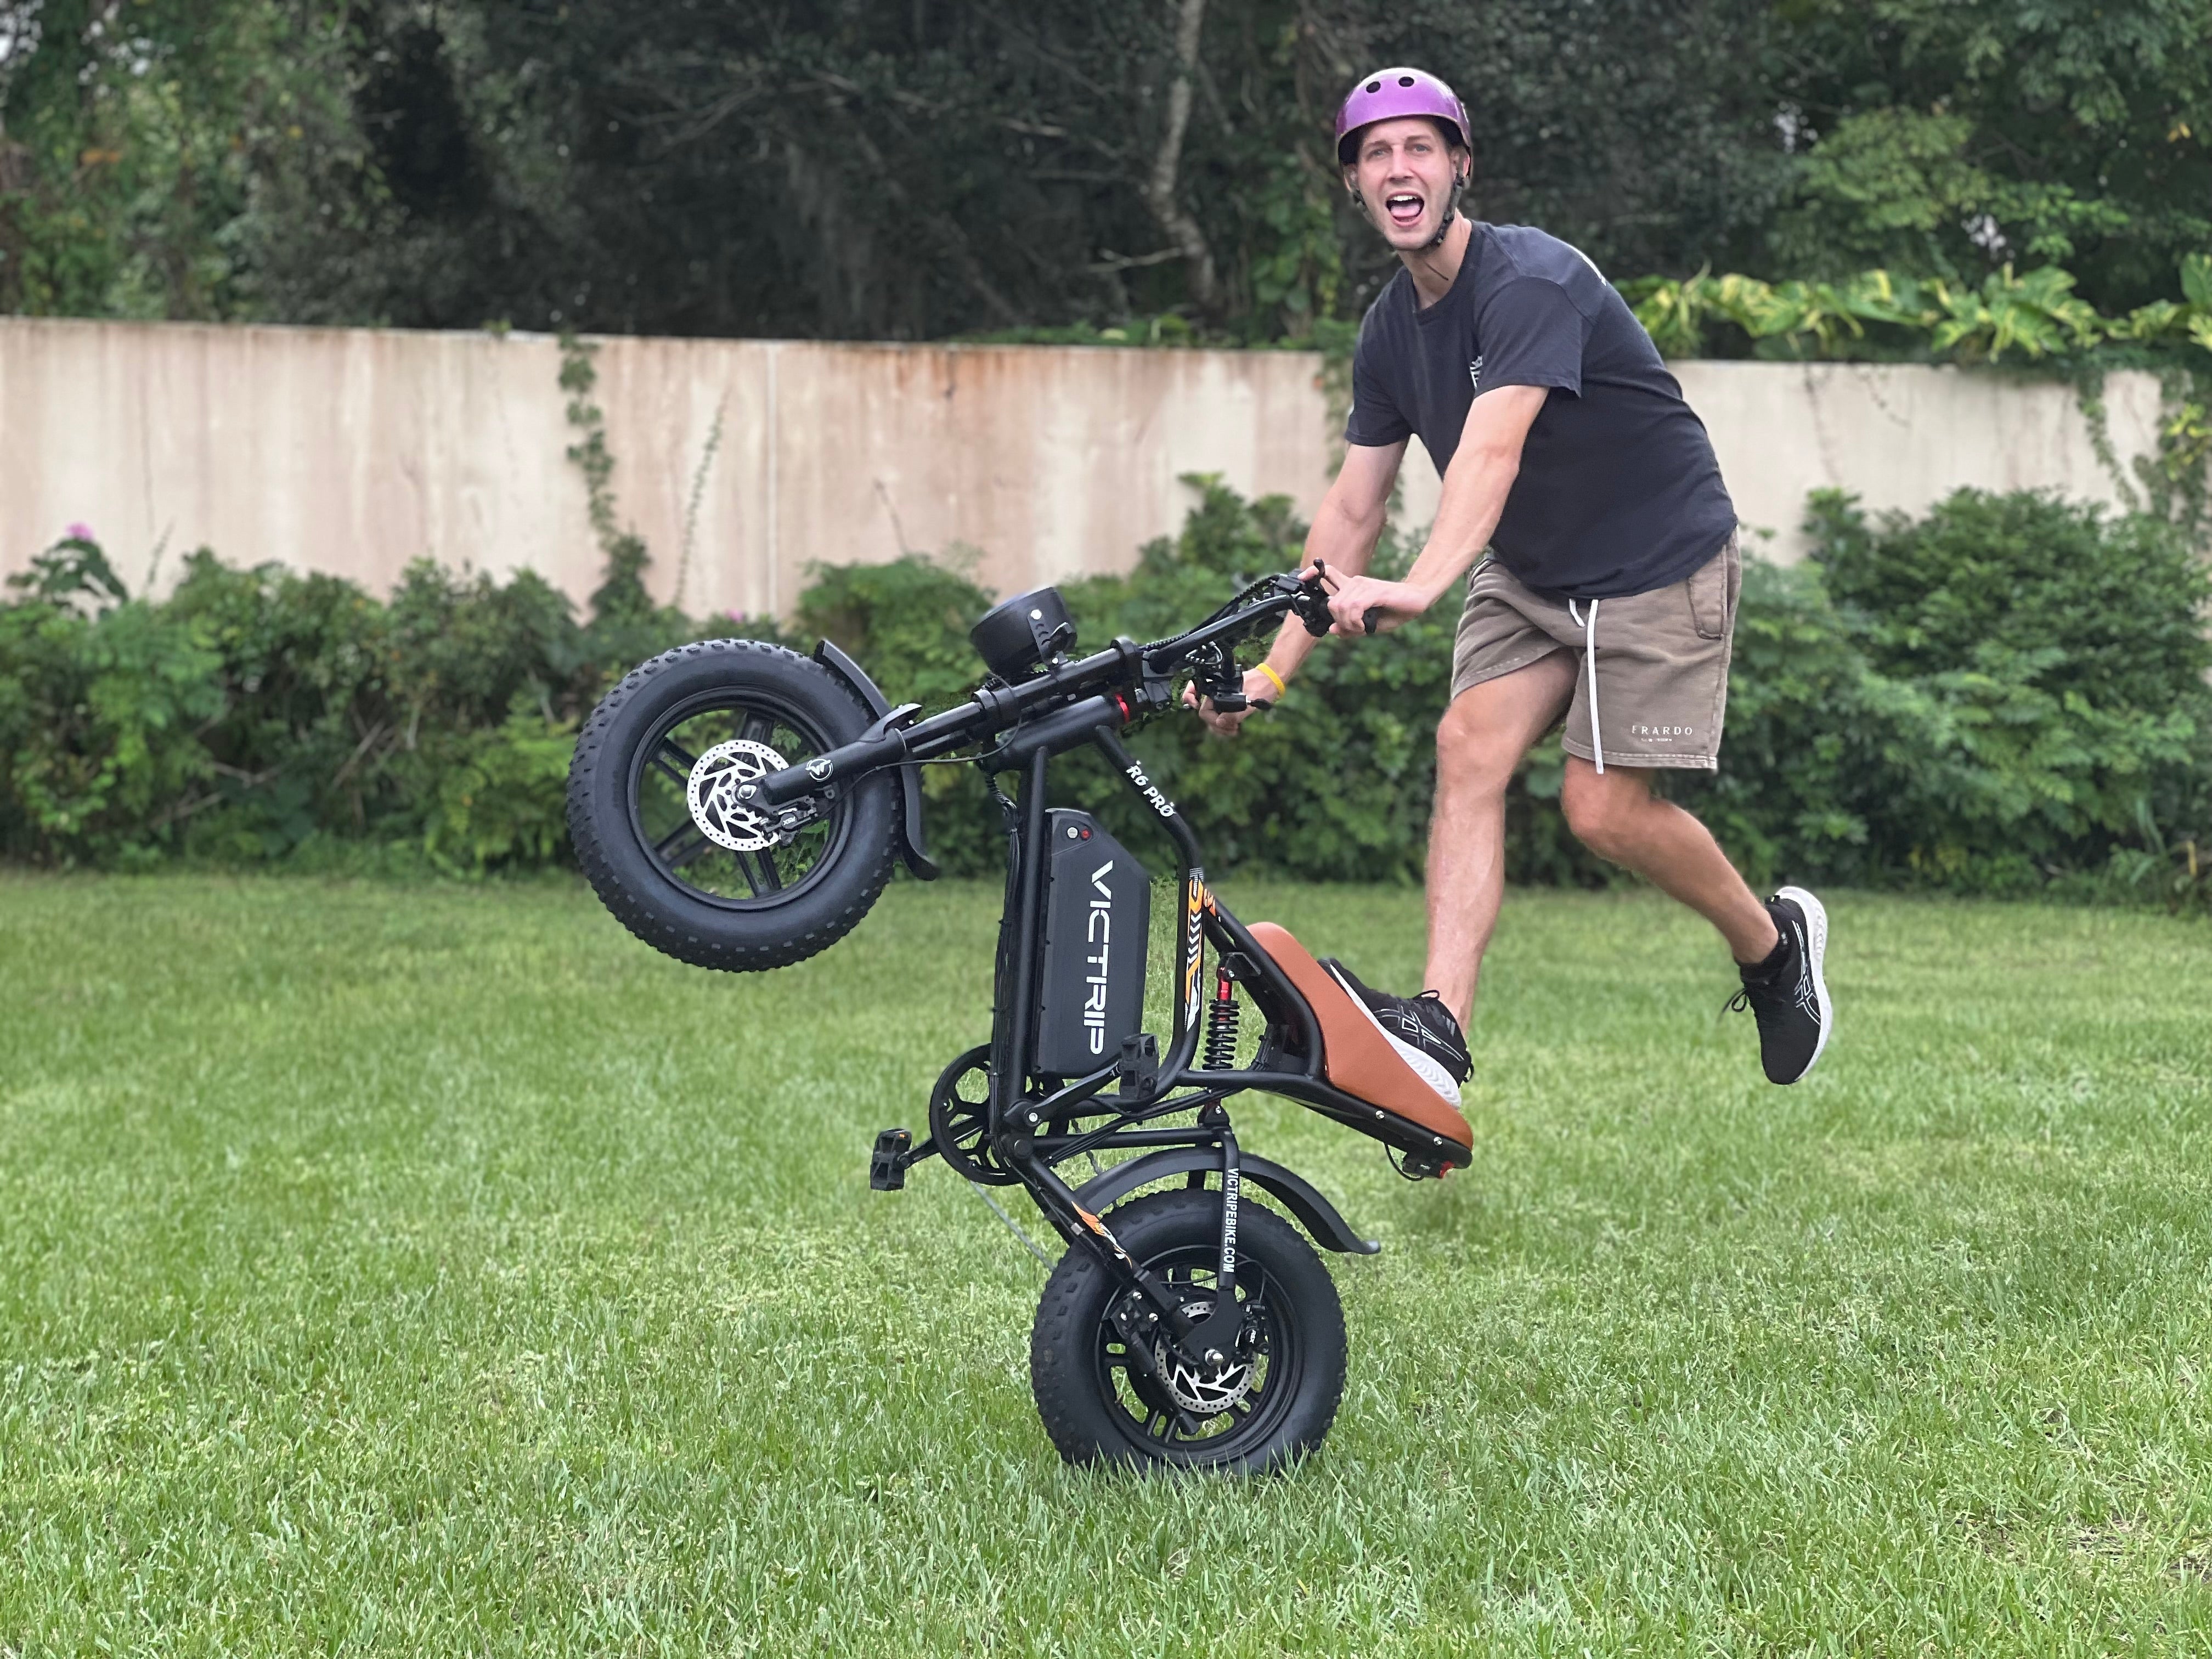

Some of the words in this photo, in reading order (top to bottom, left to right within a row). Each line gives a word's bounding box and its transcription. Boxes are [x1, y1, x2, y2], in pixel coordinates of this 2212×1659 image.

[1126, 764, 1149, 786] R6
[1142, 786, 1176, 817] PRO
[1084, 859, 1114, 1055] VICTRIP
[1222, 1167, 1239, 1273] VICTRIPEBIKE.COM
